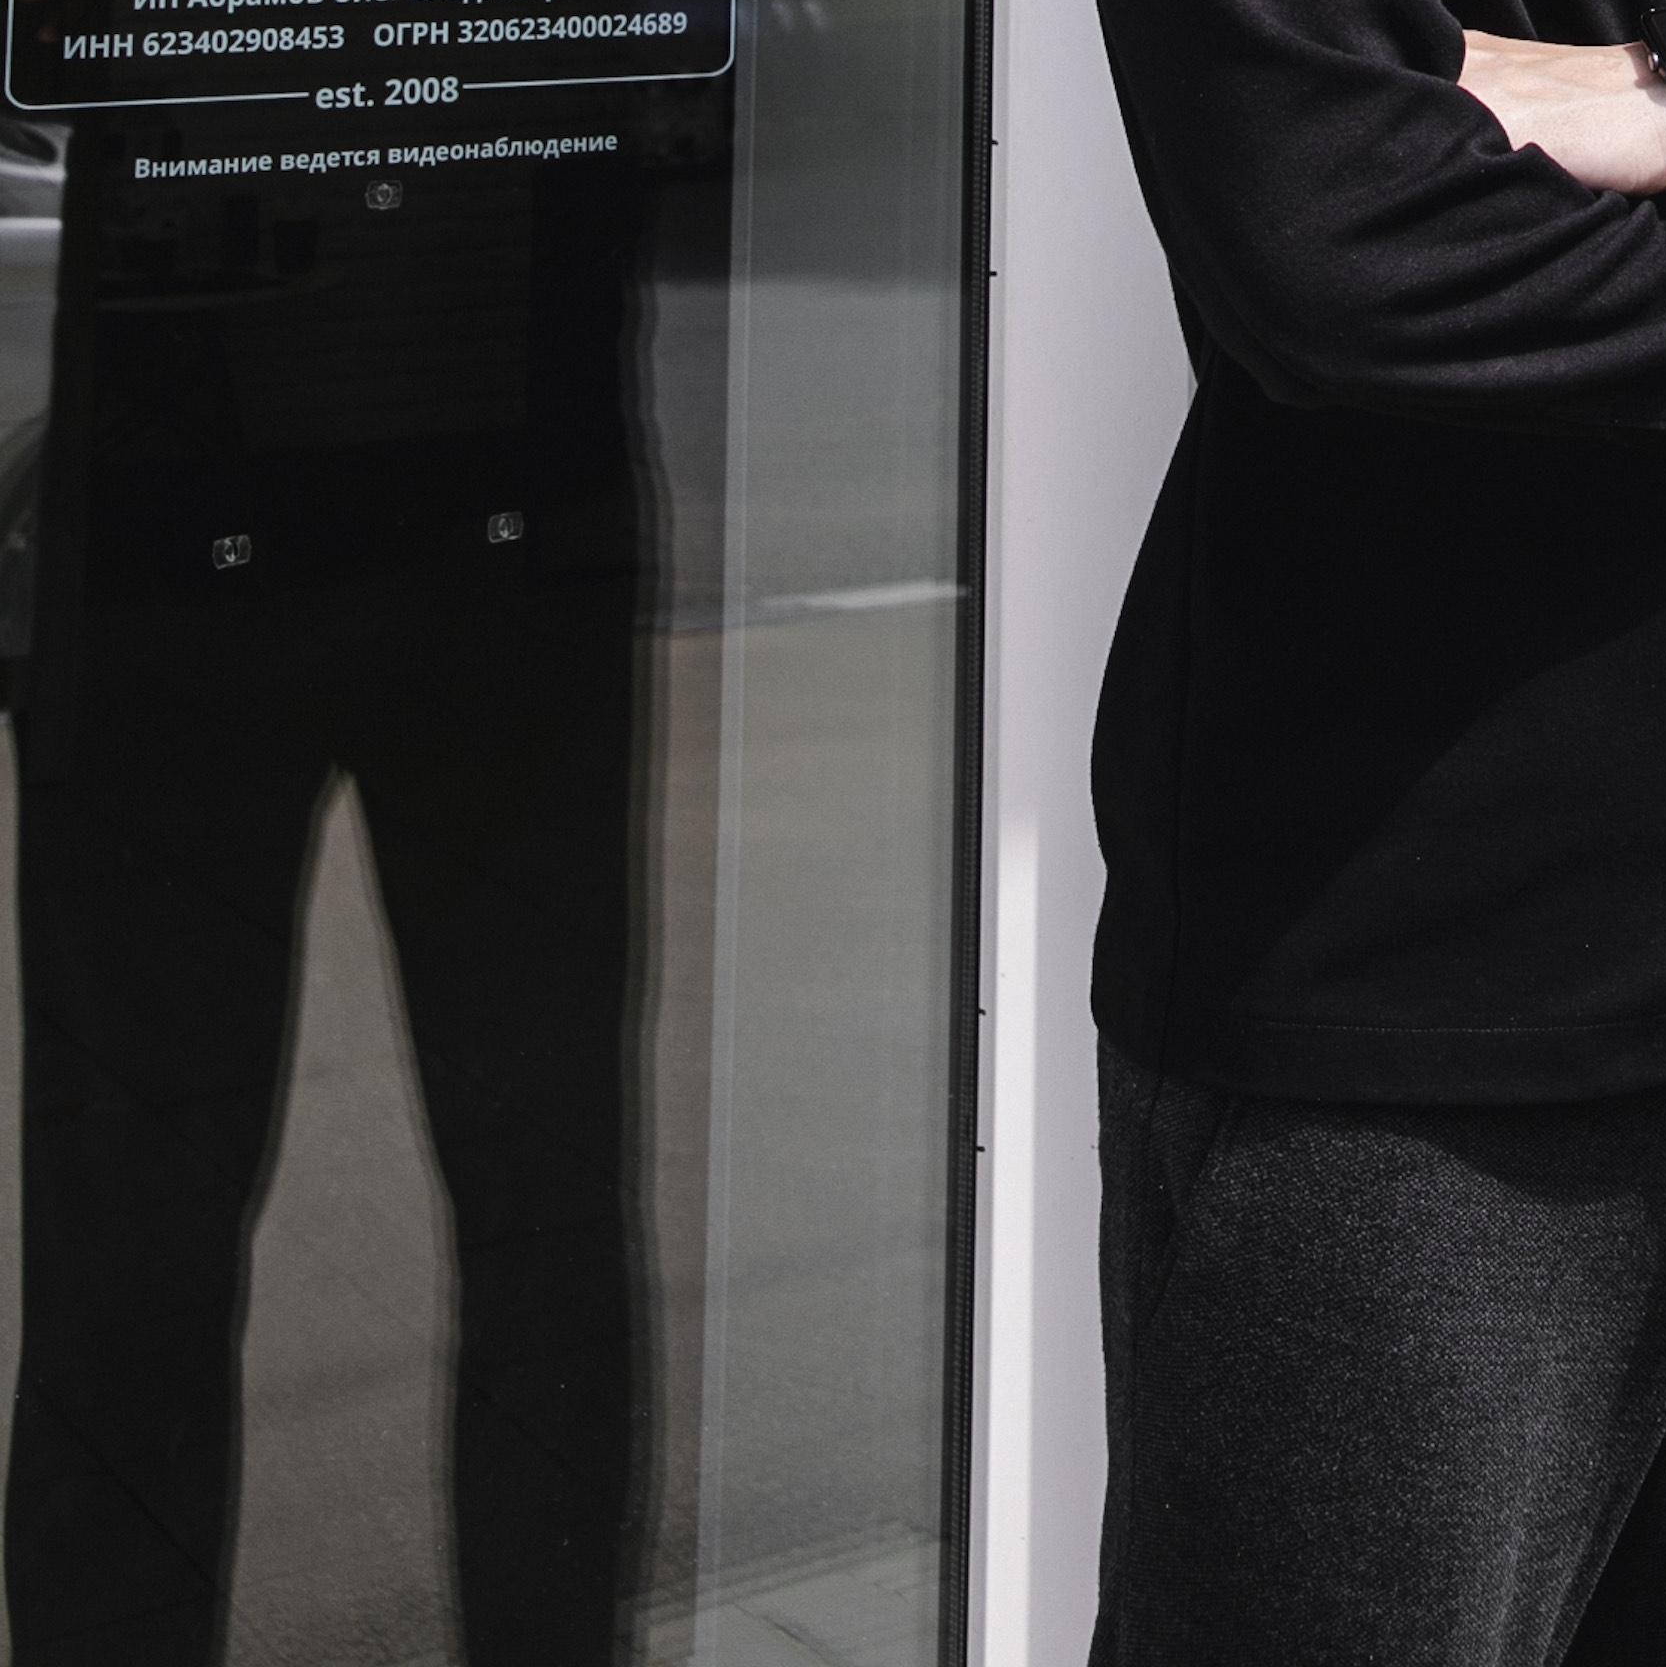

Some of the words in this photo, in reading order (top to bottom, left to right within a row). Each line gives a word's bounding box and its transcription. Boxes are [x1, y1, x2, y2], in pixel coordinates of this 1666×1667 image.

[63, 33, 134, 60] ИНН
[142, 24, 345, 57] 623402908453
[373, 20, 449, 47] ОГРН
[457, 11, 688, 44] 320623400024689
[315, 82, 375, 109] est.
[384, 76, 459, 106] 2008
[134, 153, 273, 179] Внимание
[280, 147, 380, 175] ведется
[387, 132, 619, 167] видеонаблюдение
